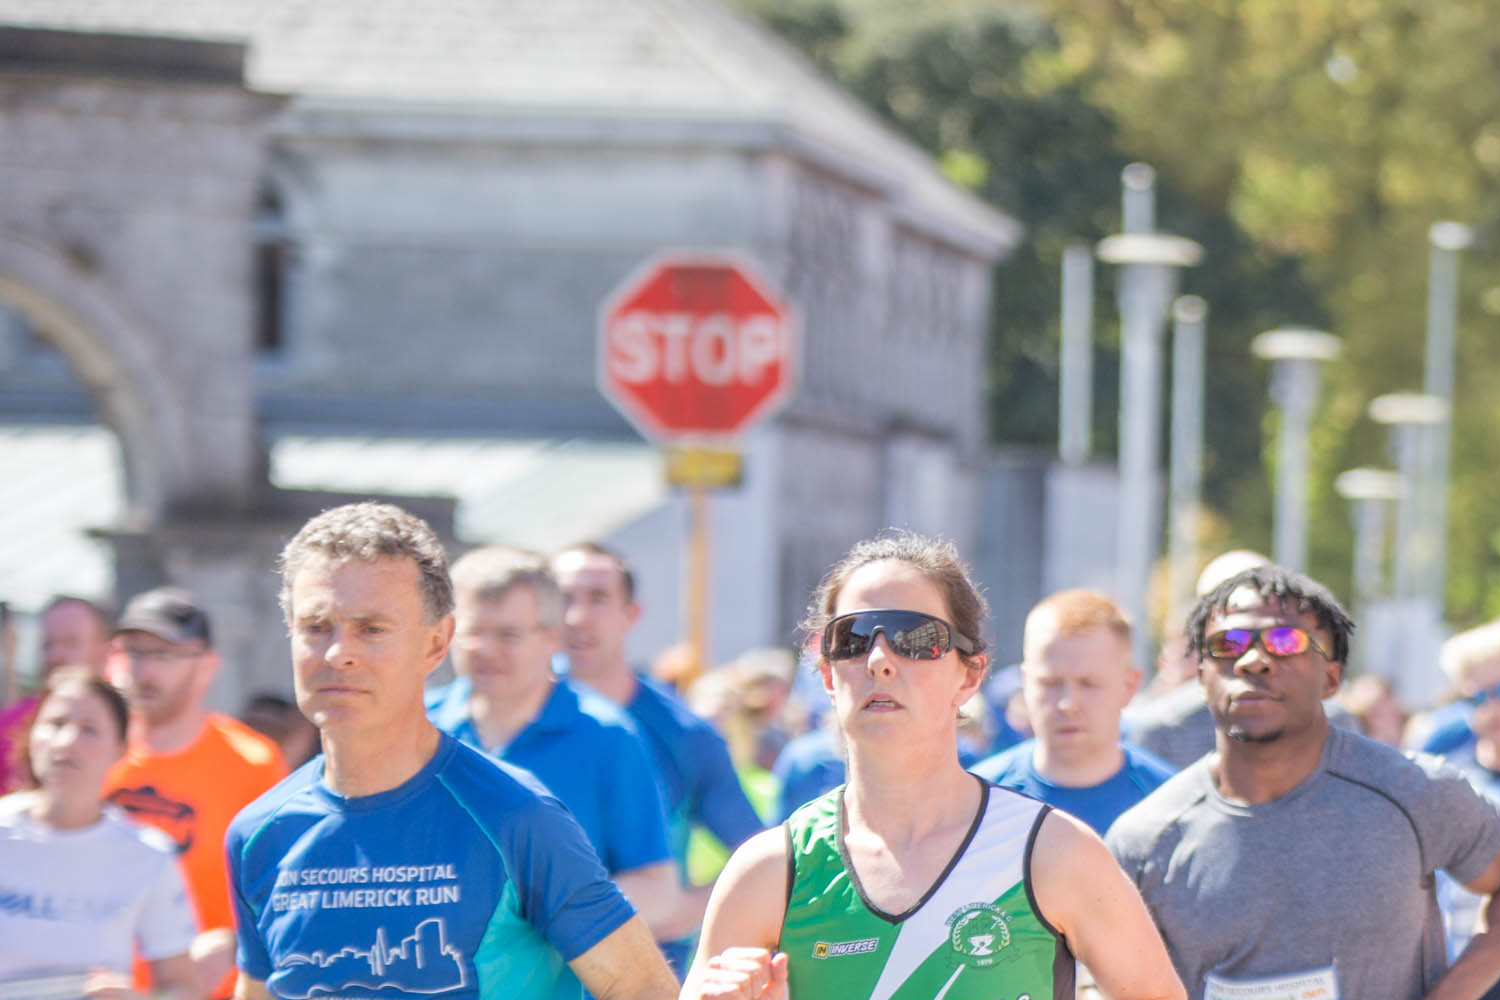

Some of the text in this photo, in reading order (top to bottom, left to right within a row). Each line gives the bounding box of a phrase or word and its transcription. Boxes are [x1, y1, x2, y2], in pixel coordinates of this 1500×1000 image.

[612, 312, 790, 388] STOP
[301, 867, 369, 886] SECOURS
[371, 863, 458, 883] HOSPITAL
[271, 885, 460, 912] GREAT LIMERICK RUN
[830, 940, 877, 955] INVERSE
